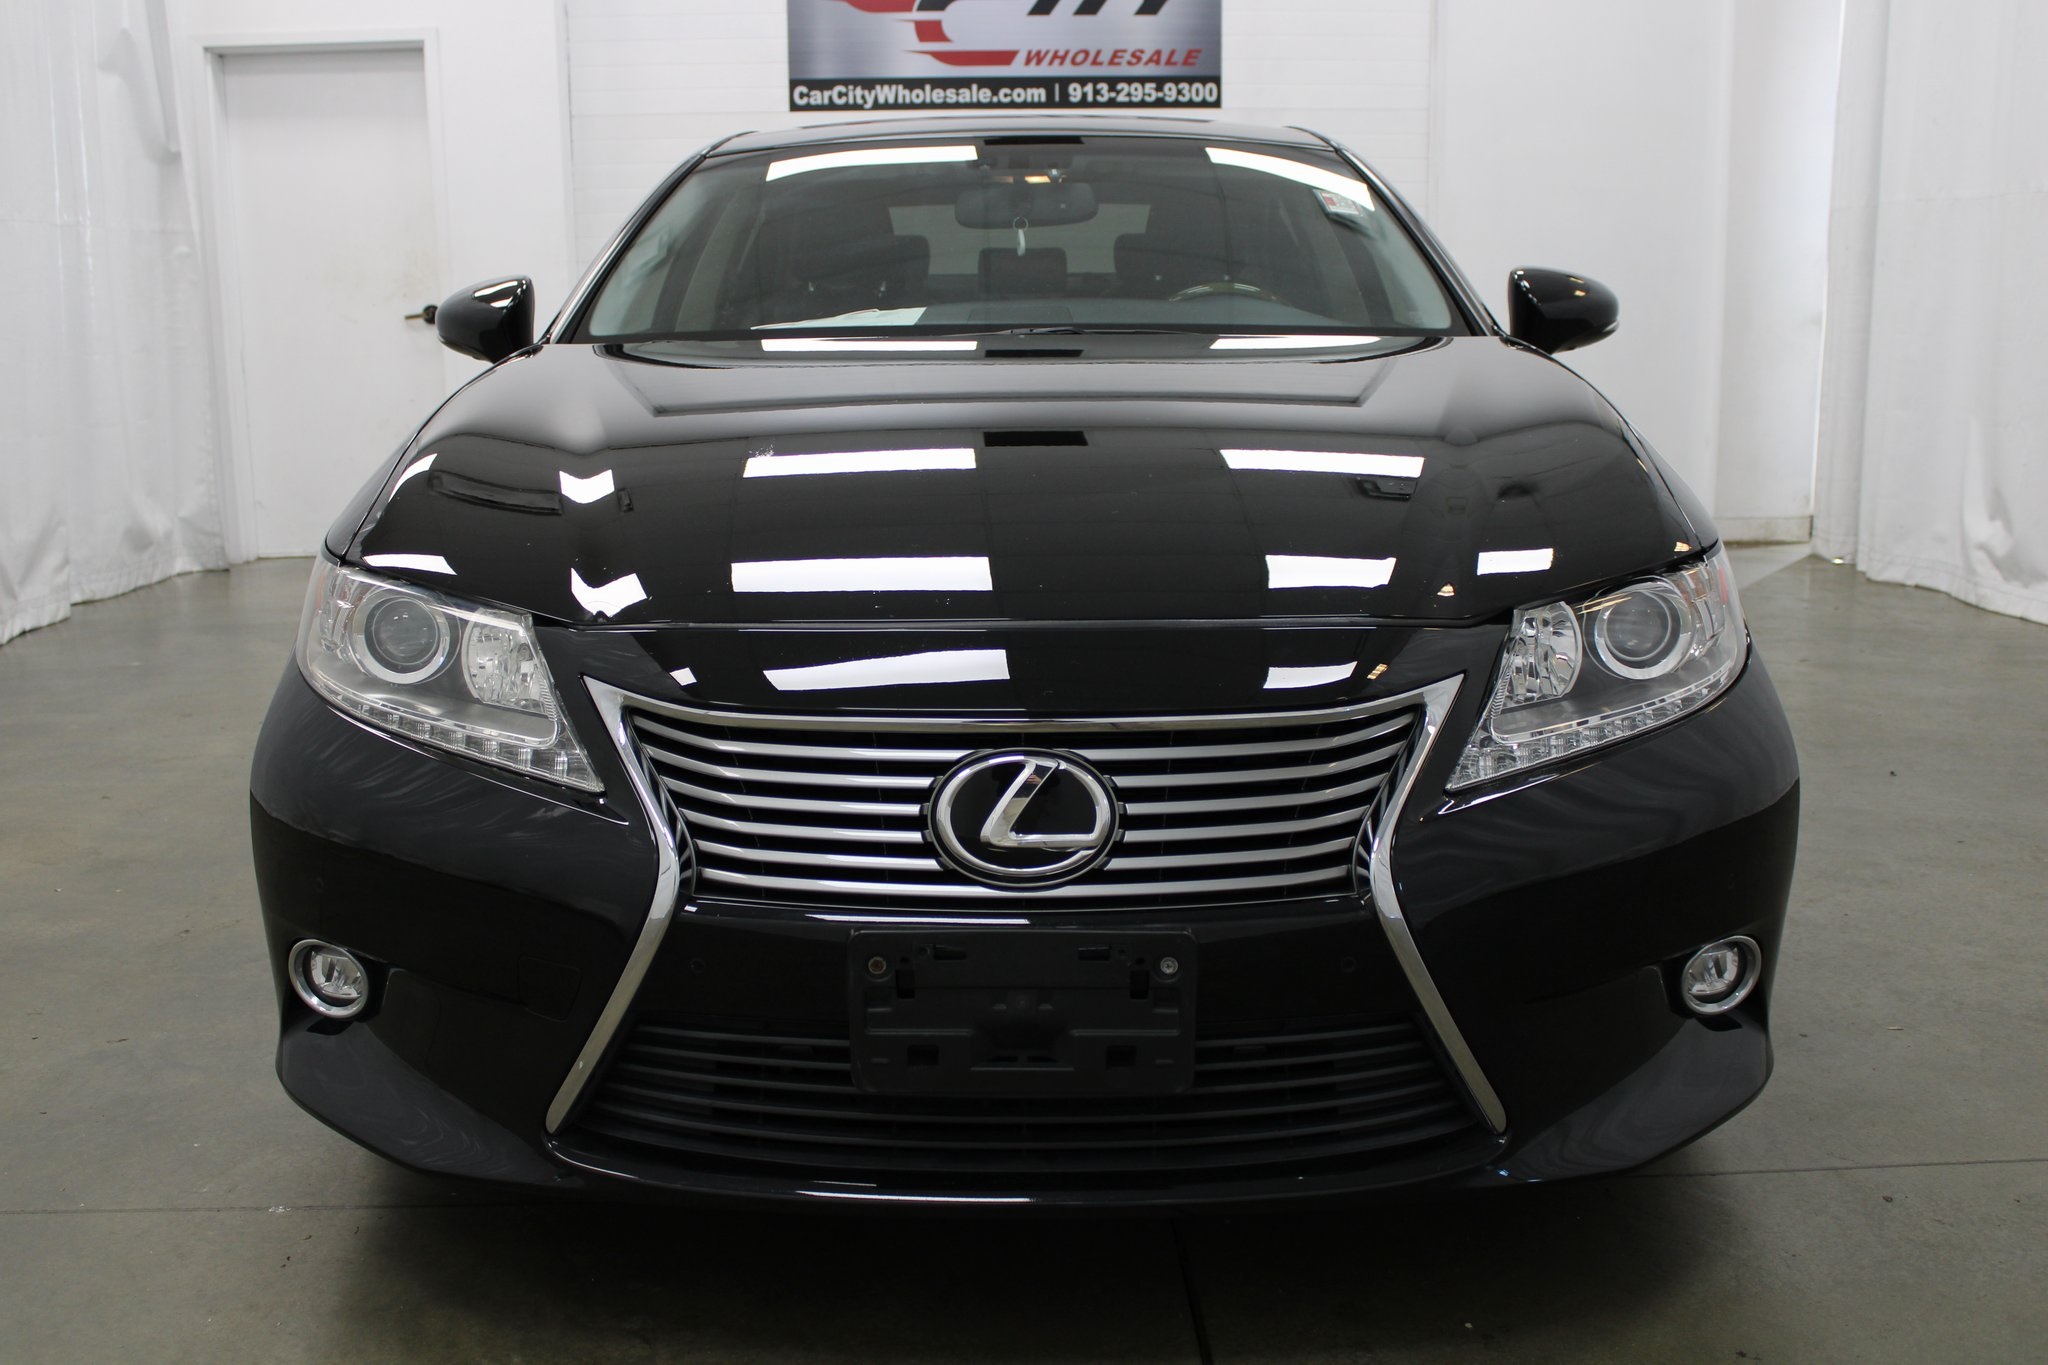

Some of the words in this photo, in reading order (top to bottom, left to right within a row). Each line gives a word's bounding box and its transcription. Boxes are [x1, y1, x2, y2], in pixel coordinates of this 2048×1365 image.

[1023, 48, 1202, 67] WHOLESALE
[793, 83, 1047, 109] CarCityWholesale.com
[1067, 82, 1218, 103] 913-295-9300
